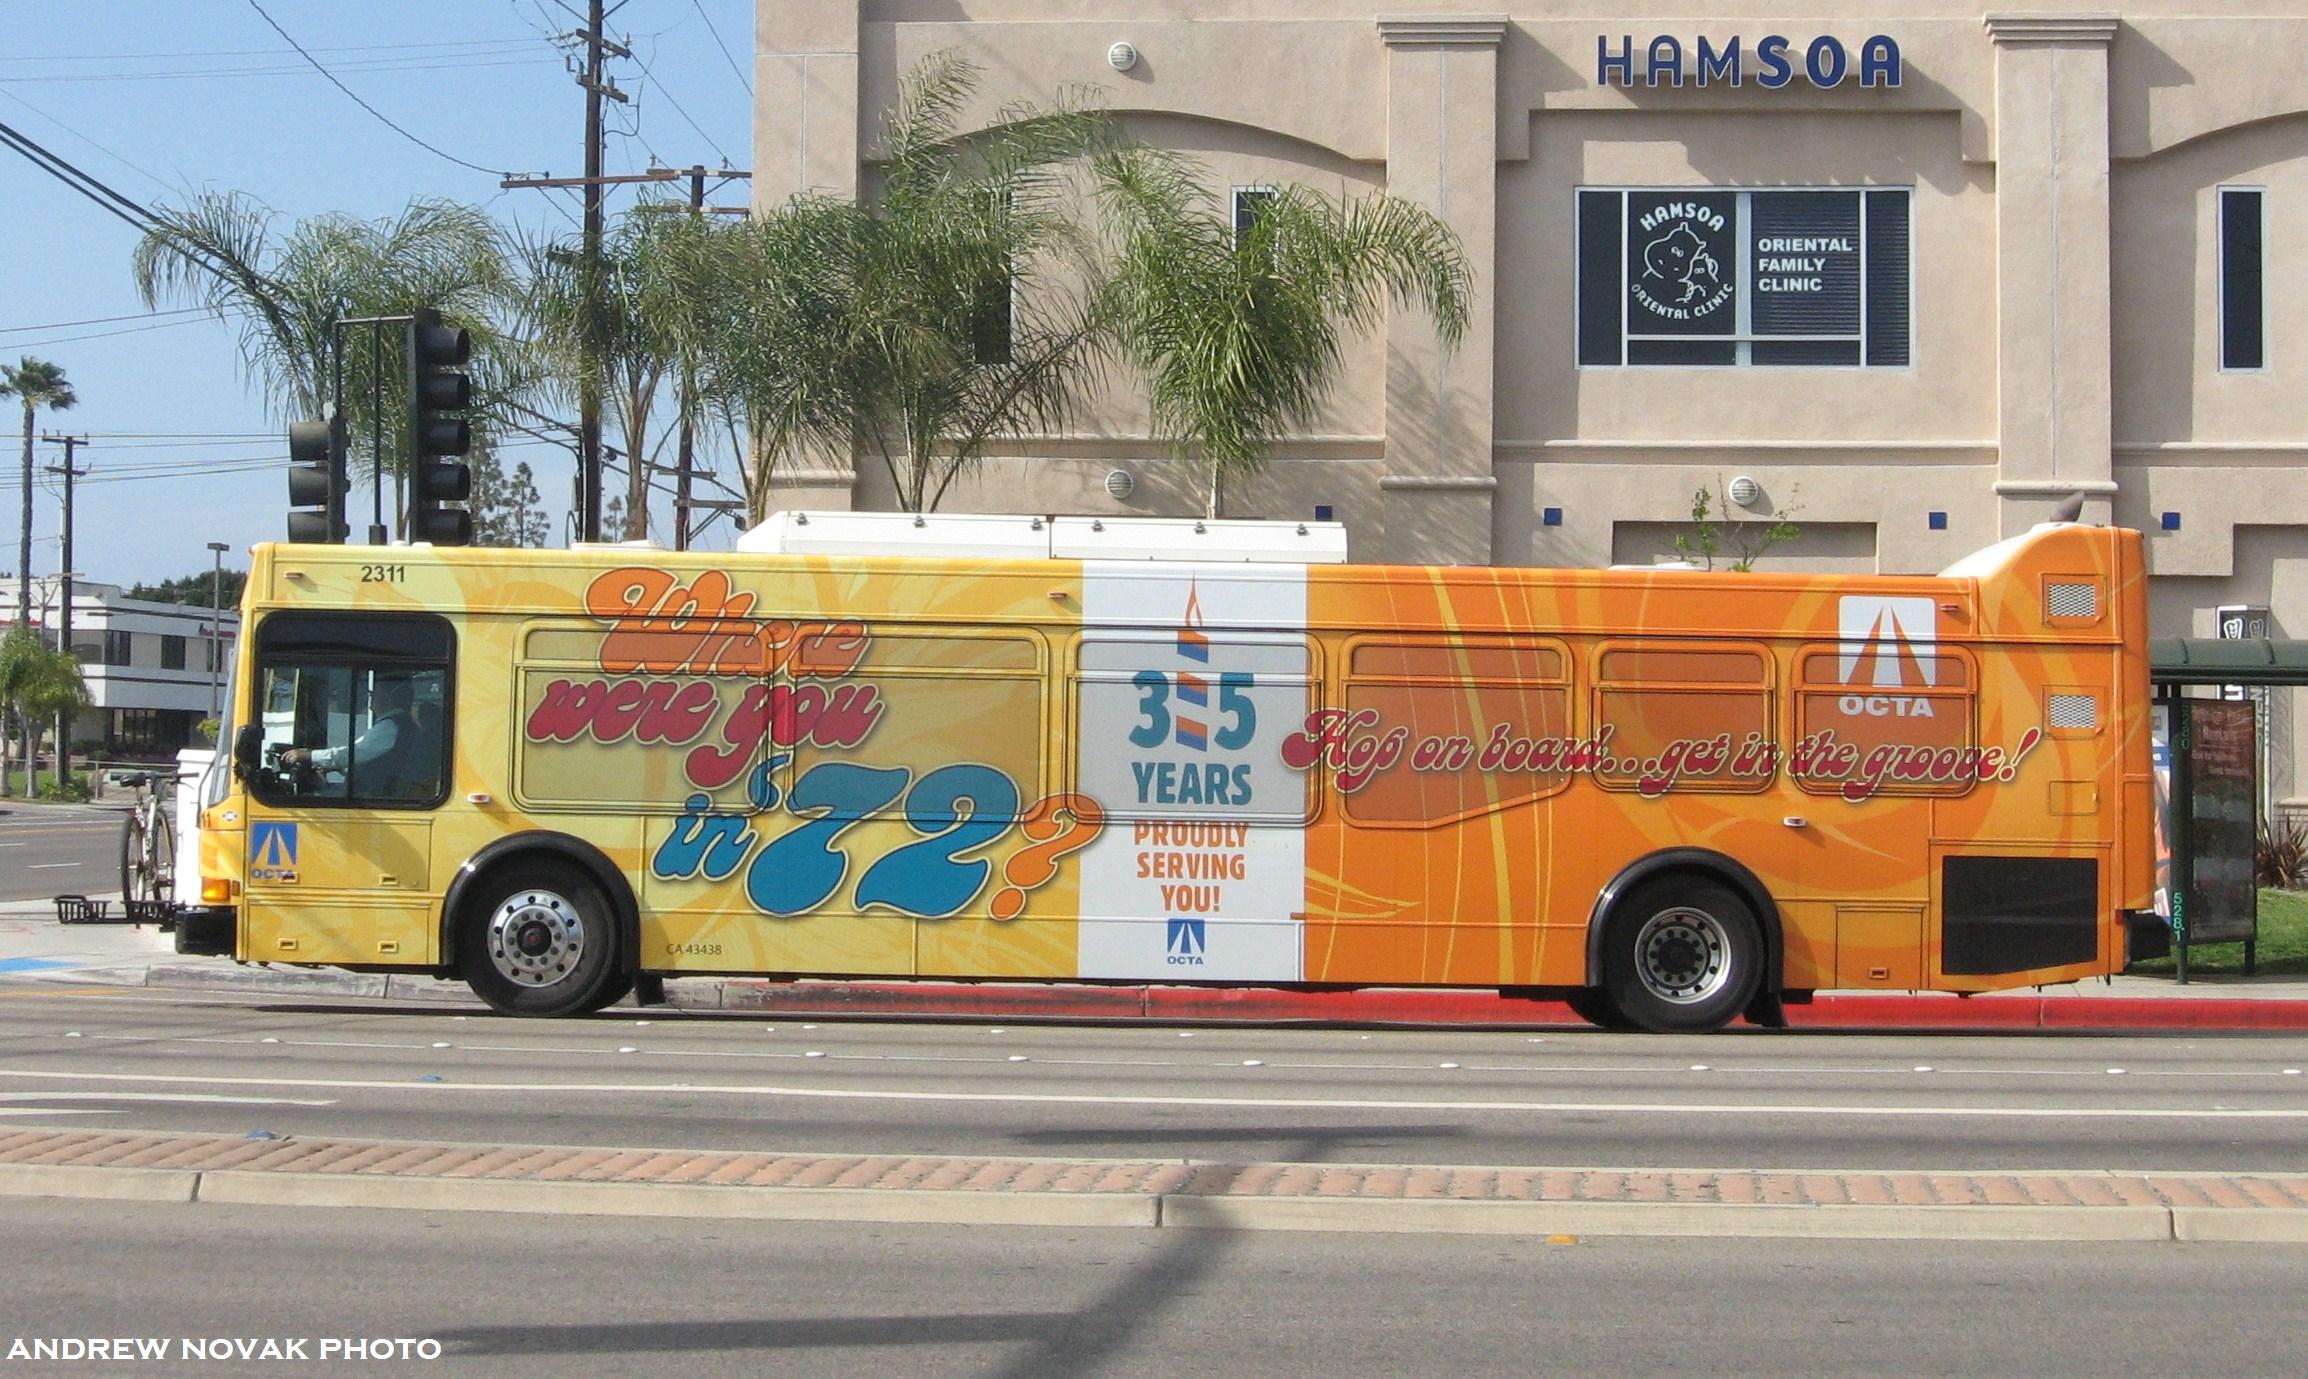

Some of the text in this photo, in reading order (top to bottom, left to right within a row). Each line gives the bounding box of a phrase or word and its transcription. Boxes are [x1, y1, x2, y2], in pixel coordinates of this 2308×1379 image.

[1596, 33, 1902, 89] HAMSOA
[1639, 202, 1726, 232] HAMSOA
[1759, 238, 1853, 252] ORIENTAL
[1759, 258, 1826, 272] FAMILY
[1758, 278, 1823, 292] CLINIC
[1631, 283, 1734, 320] ORIENTAL CLINIC
[361, 565, 405, 583] 2311
[584, 567, 869, 680] Where
[1129, 670, 1257, 751] 35
[1838, 694, 1935, 718] OCTA
[525, 678, 885, 789] were you
[1280, 707, 1408, 793] Hop
[1410, 735, 1473, 770] on
[1730, 731, 1784, 776] in
[1787, 728, 1859, 779] the
[1840, 726, 2042, 803] groove!
[1131, 762, 1253, 806] YEARS
[651, 791, 759, 881] in
[1133, 820, 1249, 848] PROUDLY
[1136, 852, 1246, 880] SERVING
[1160, 884, 1221, 913] YOU!
[2173, 892, 2183, 941] 5281
[666, 943, 722, 955] CA 43438
[1166, 956, 1204, 965] OCTA
